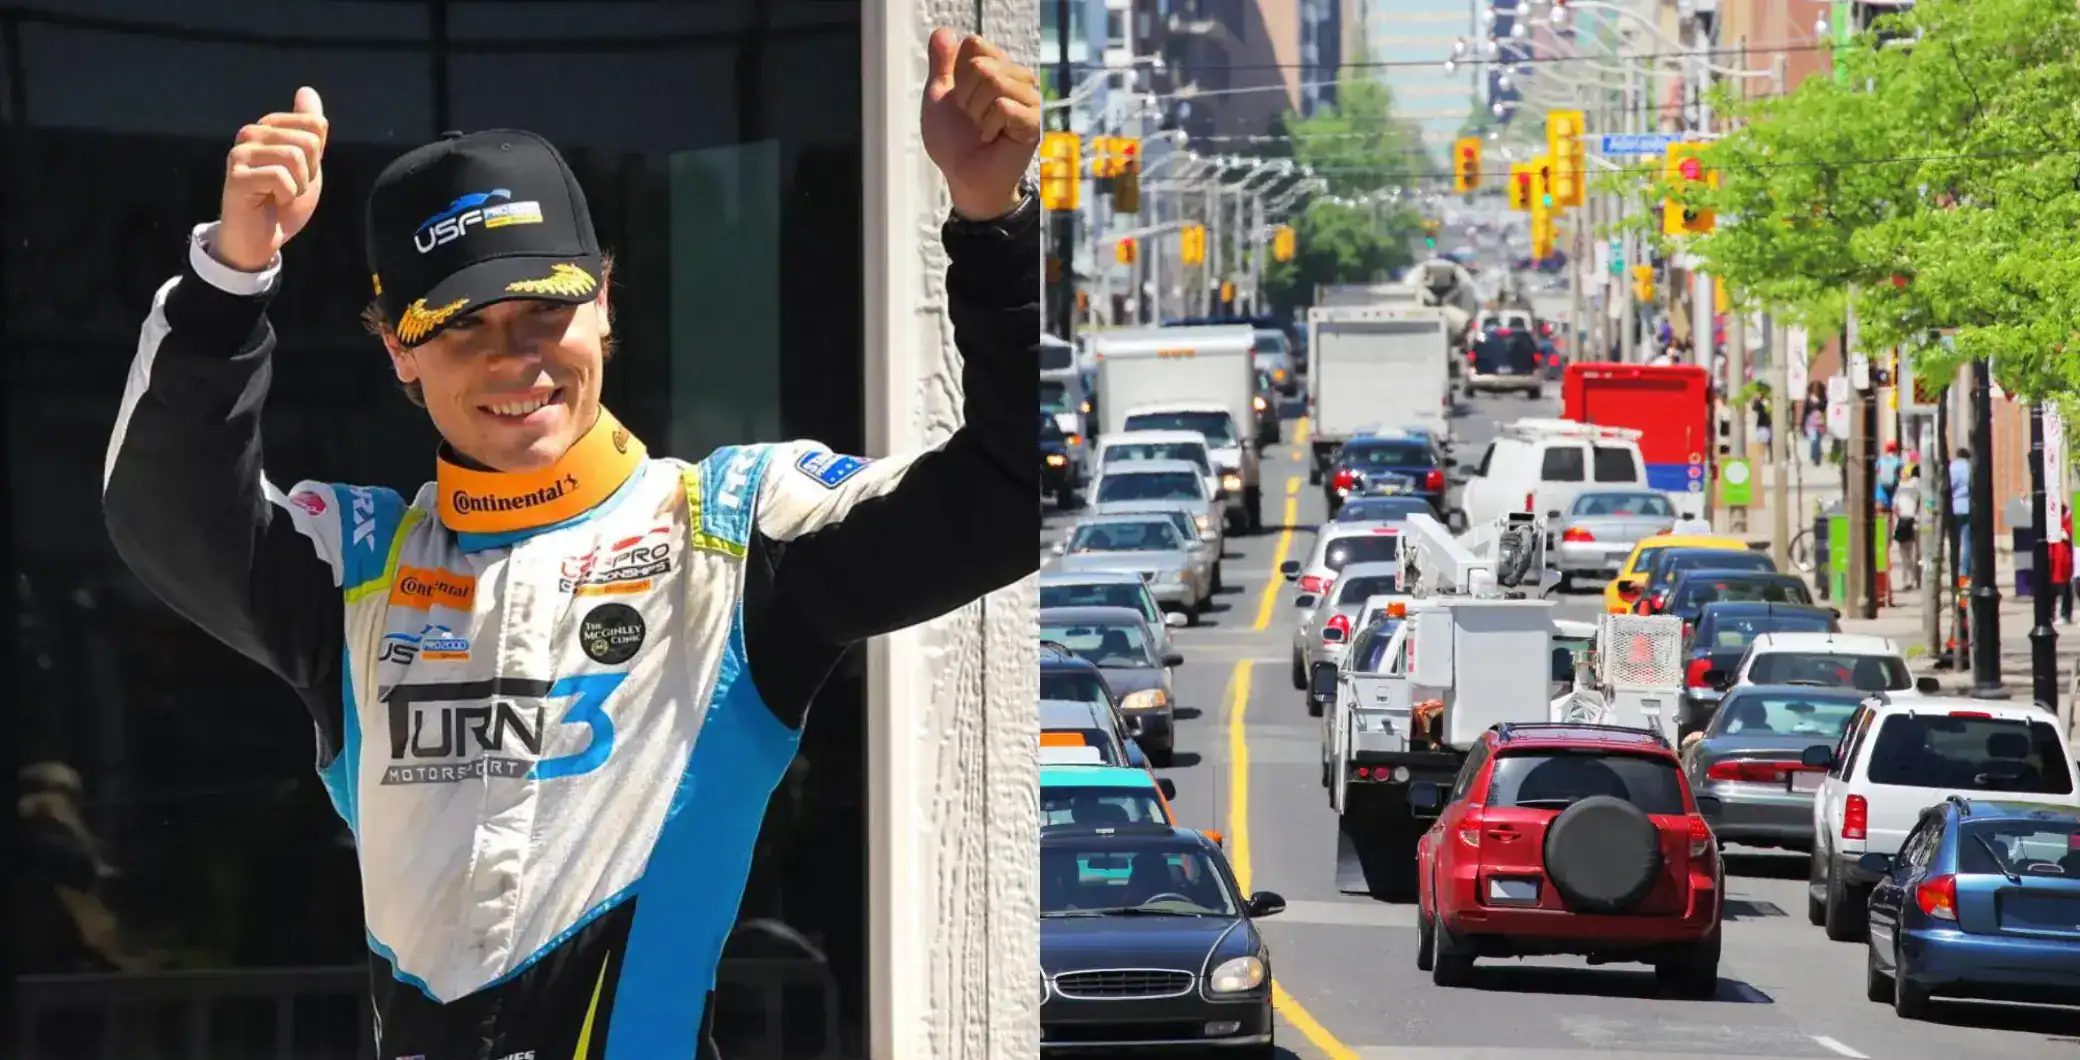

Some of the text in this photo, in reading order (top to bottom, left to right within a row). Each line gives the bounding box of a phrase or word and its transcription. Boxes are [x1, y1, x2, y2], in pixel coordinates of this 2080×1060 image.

[414, 209, 483, 254] USF
[453, 479, 564, 515] Continental
[381, 672, 629, 781] TURN 3
